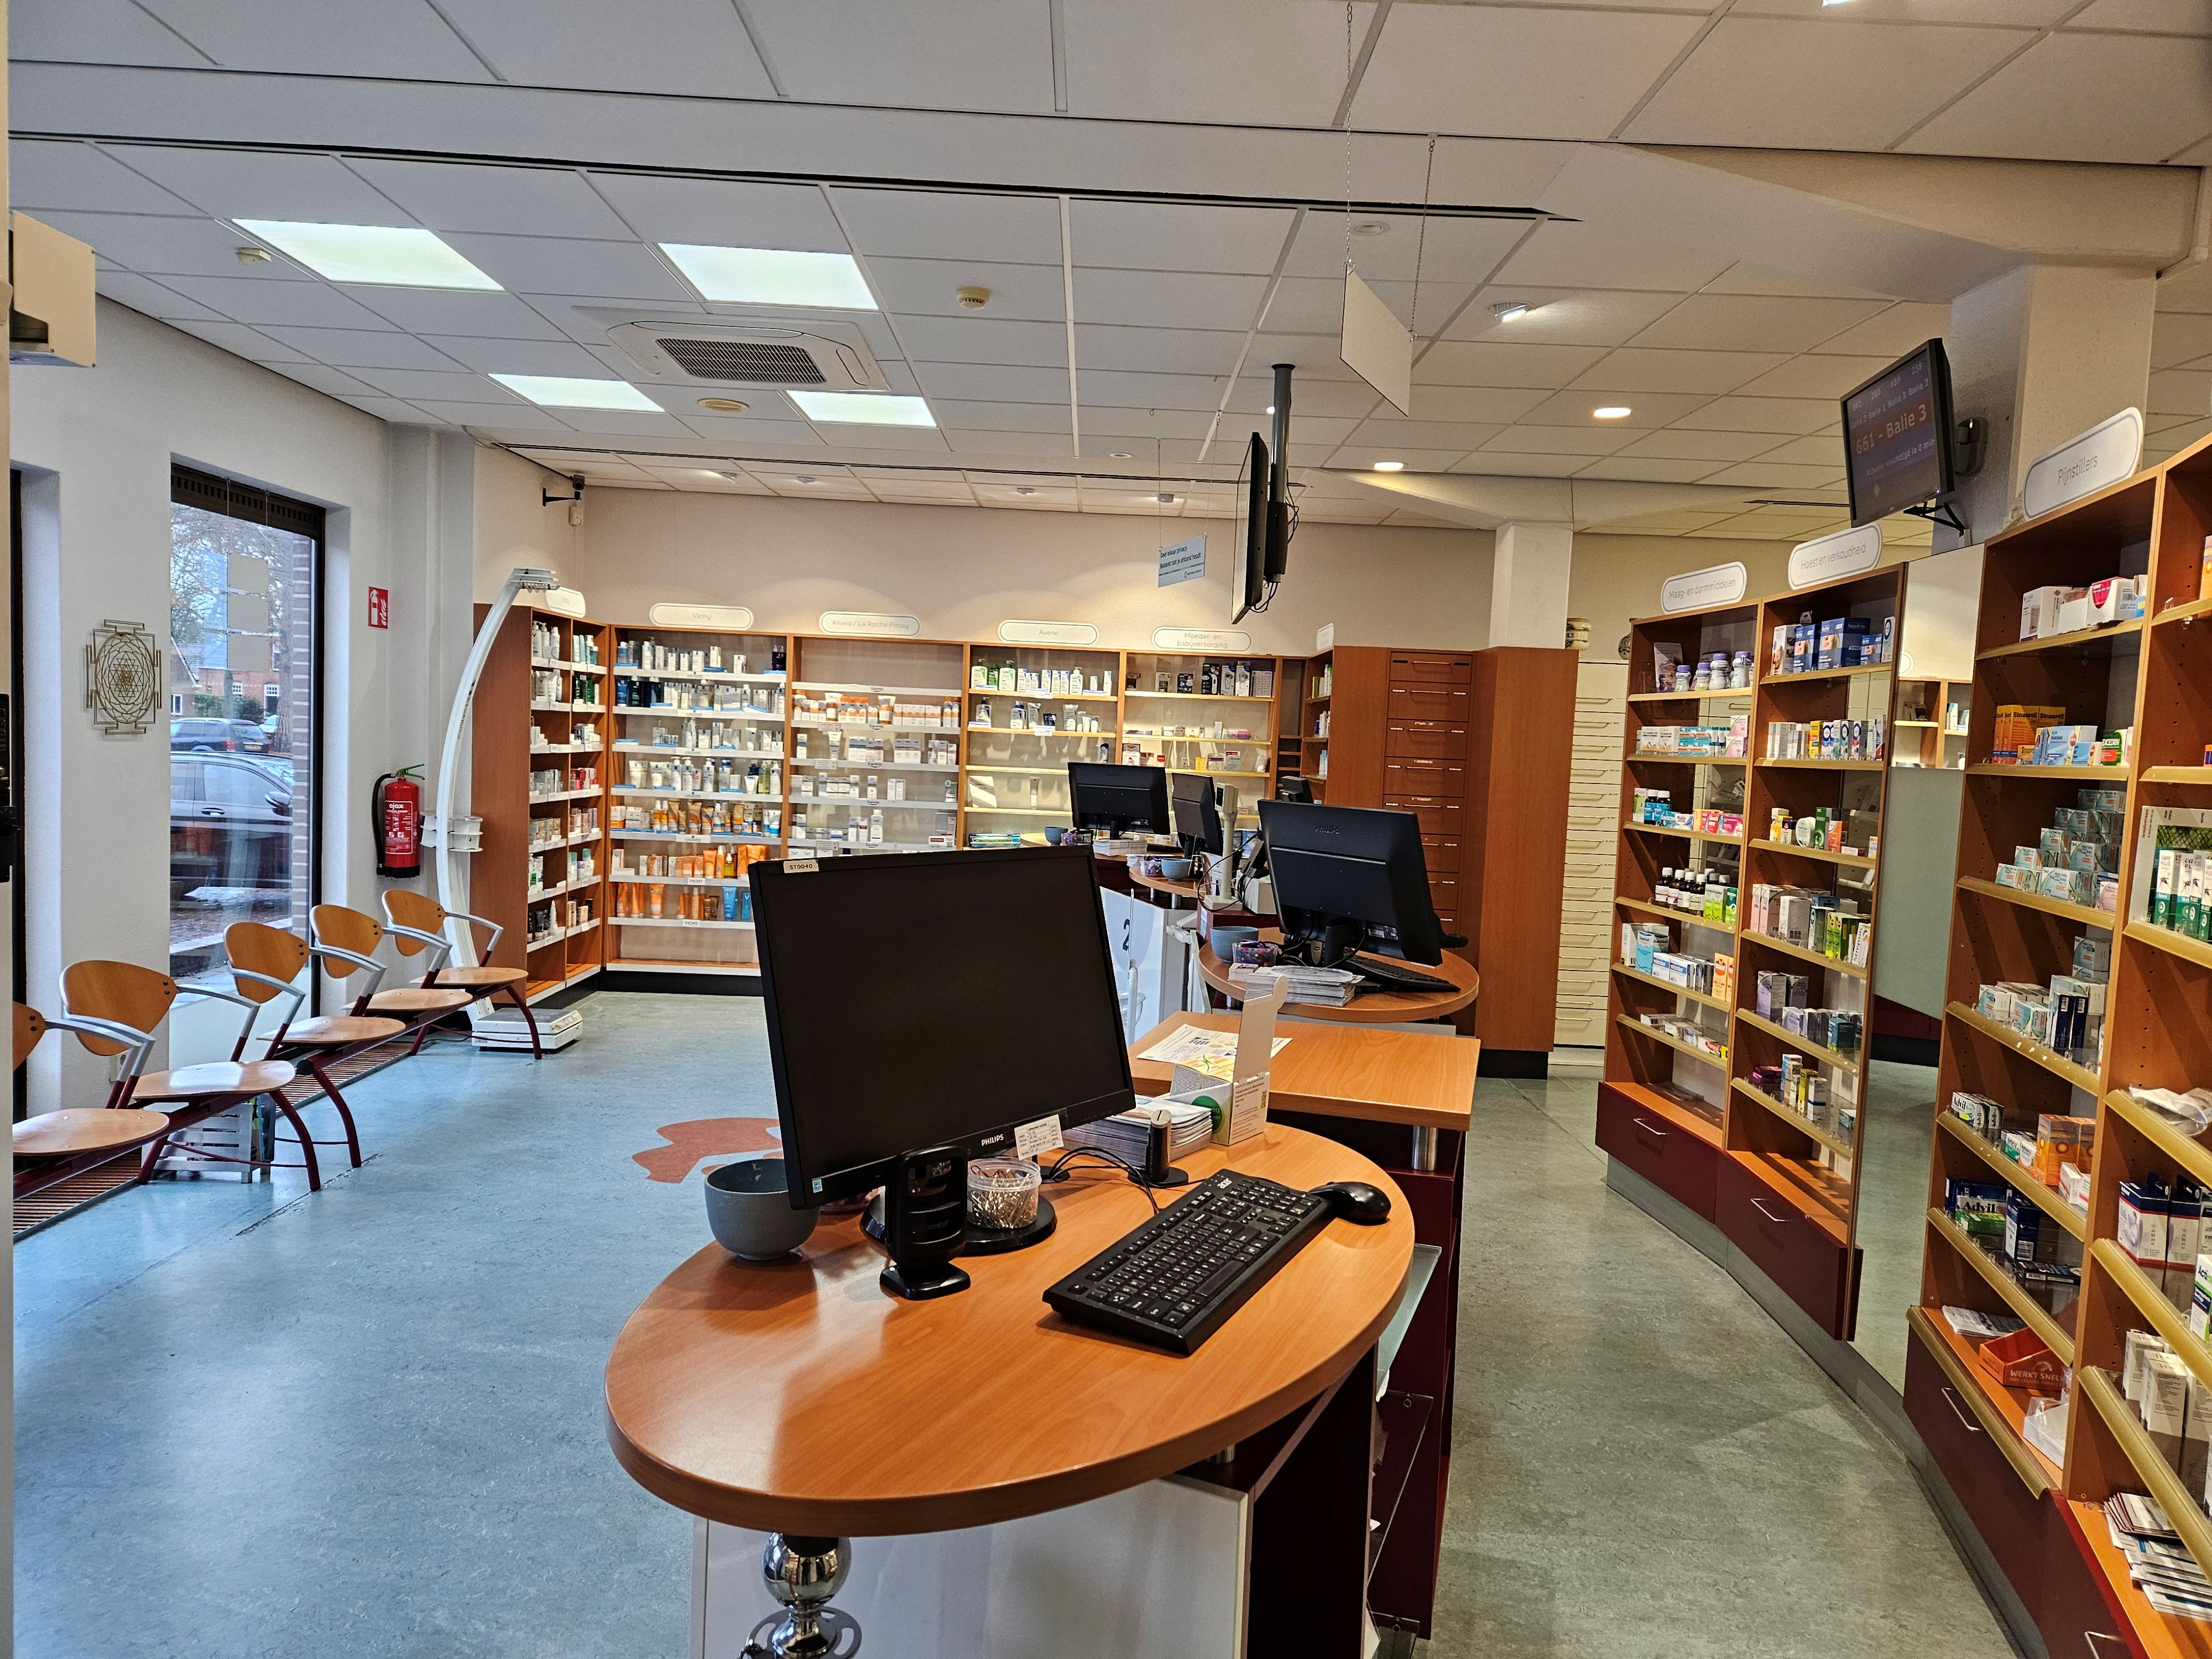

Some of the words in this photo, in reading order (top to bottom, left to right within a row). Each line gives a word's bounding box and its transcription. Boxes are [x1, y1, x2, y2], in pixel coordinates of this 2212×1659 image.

[1924, 378, 1929, 387] 3
[1856, 432, 1875, 455] 661
[1886, 412, 1916, 439] Balie
[1918, 404, 1926, 421] 3
[2058, 455, 2098, 486] Pijnstillers
[1177, 546, 1188, 554] privacy
[1801, 556, 1818, 571] Hoest
[1819, 555, 1827, 565] en
[1827, 542, 1866, 563] verkoudheid
[1668, 588, 1686, 600] Maag-
[1686, 587, 1694, 596] en
[1694, 578, 1736, 594] darmmiddelen
[692, 612, 712, 622] Vichy
[831, 618, 851, 628] Ahava
[867, 620, 888, 629] Roche
[889, 621, 910, 631] Posay
[1038, 628, 1059, 637] Avene
[1176, 640, 1228, 649] babyverzorging
[389, 802, 404, 811] ajax
[1314, 823, 1340, 834] PHILIPS
[1123, 919, 1130, 952] 2
[1953, 1097, 1967, 1110] Advil
[981, 1134, 1004, 1146] PHILIPS
[1217, 1177, 1233, 1190] acer
[1963, 1201, 1996, 1213] Advil
[2010, 1370, 2038, 1379] WERKT
